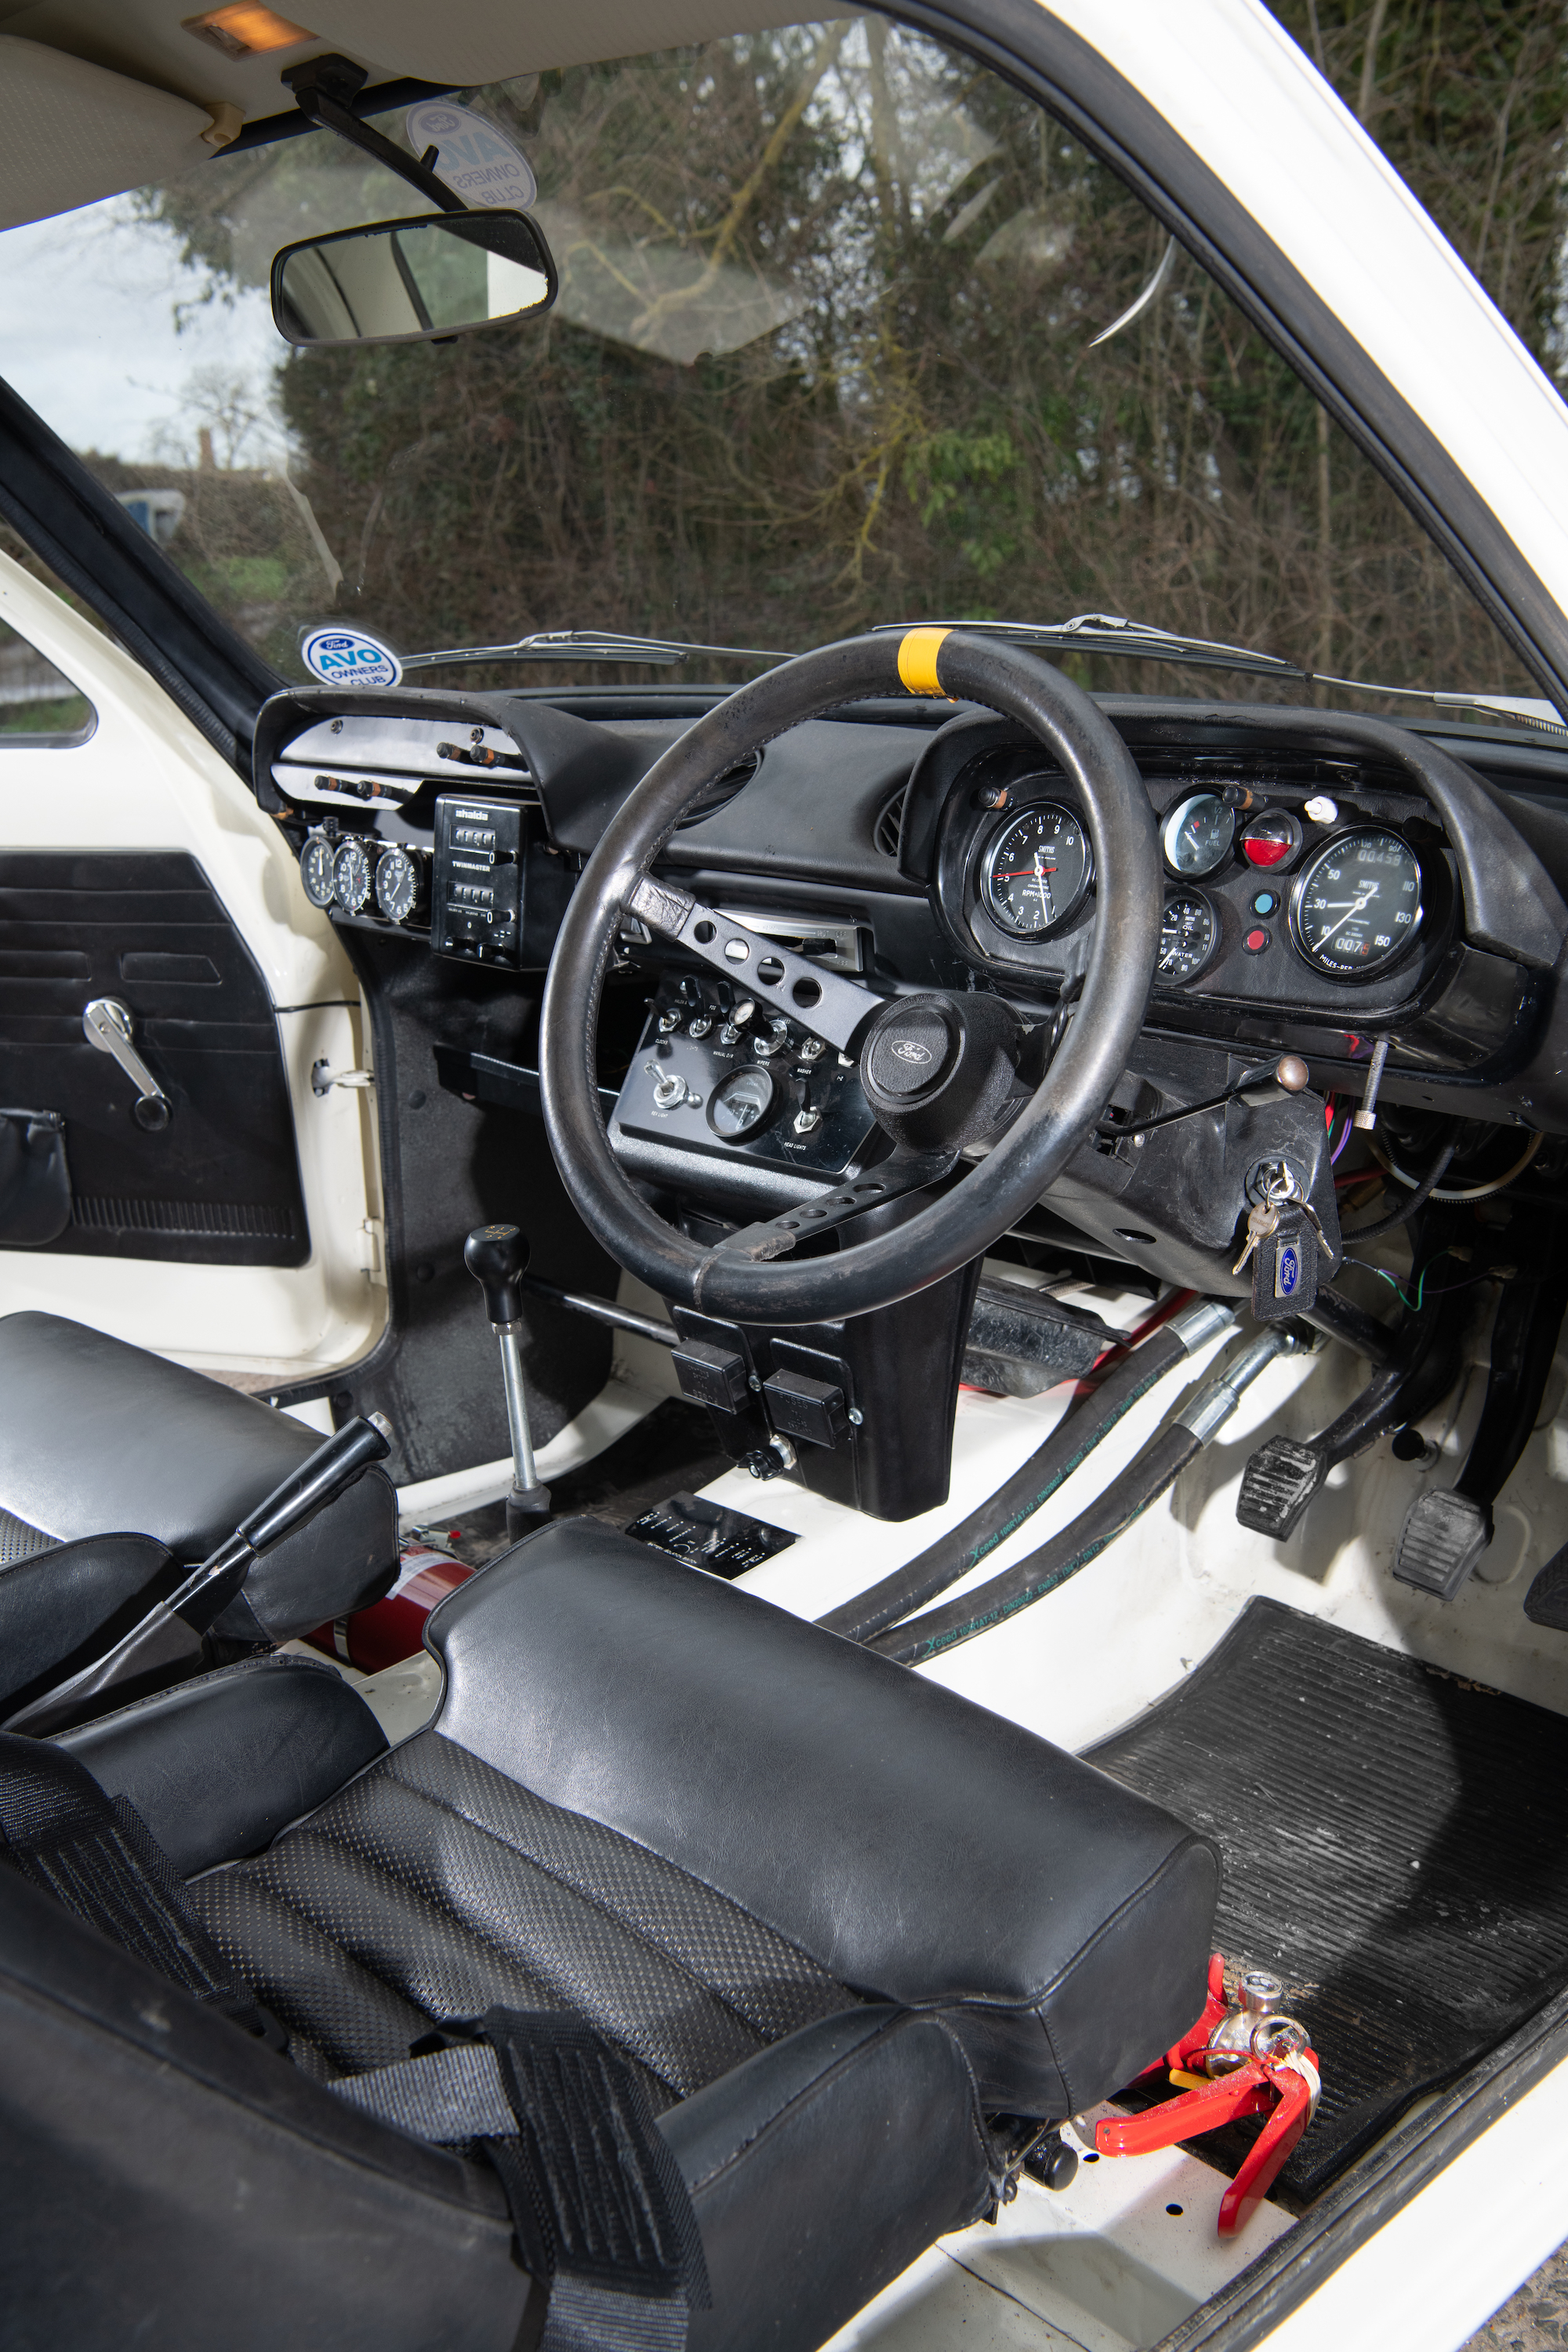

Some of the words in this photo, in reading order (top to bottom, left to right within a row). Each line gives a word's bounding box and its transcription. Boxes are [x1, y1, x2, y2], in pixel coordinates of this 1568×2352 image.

[325, 640, 349, 649] Ford
[319, 649, 382, 670] AVO
[331, 665, 389, 679] OWNERS
[350, 676, 387, 685] CLUB
[461, 809, 488, 821] halda
[1037, 825, 1044, 835] 8
[1054, 825, 1061, 834] 9
[1022, 836, 1029, 844] 7
[1066, 837, 1074, 846] 10
[1038, 845, 1055, 854] SMITHS
[350, 852, 357, 861] 12
[1008, 852, 1015, 862] 6
[340, 862, 347, 872] 10
[395, 859, 402, 868] 12
[452, 861, 490, 872] TWINMASTER
[339, 873, 343, 881] 9
[385, 870, 392, 879] 10
[1328, 869, 1341, 880] 50
[340, 884, 346, 893] 8
[383, 880, 389, 889] 9
[1359, 880, 1380, 890] SMITHS
[1403, 881, 1415, 891] 110
[345, 893, 350, 902] 7
[358, 895, 363, 904] 5
[385, 892, 390, 901] 8
[1008, 893, 1014, 902] 4
[351, 898, 356, 906] 6
[390, 902, 395, 911] 7
[1314, 898, 1327, 909] 30
[397, 906, 401, 914] 6
[403, 904, 408, 913] 5
[1018, 906, 1025, 916] 3
[1033, 910, 1040, 920] 2
[1395, 912, 1411, 924] 130
[1321, 925, 1330, 936] 10
[1374, 935, 1391, 947] 150
[898, 1044, 925, 1061] Ford
[1283, 1258, 1295, 1286] Ford
[968, 1533, 999, 1569] Xceed
[1000, 1502, 1035, 1537] 100R1AT-12
[1037, 1473, 1064, 1503] DIN20022
[1065, 1452, 1083, 1473] EN853
[1102, 1414, 1118, 1432] DN12
[1120, 1396, 1134, 1414] MWP
[1134, 1386, 1145, 1398] 105
[1145, 1374, 1158, 1389] BAR
[922, 1629, 957, 1658] Xceed
[960, 1611, 998, 1637] 100R1AT-12
[1003, 1591, 1033, 1614] DIN20022
[1037, 1574, 1059, 1594] EN853
[1083, 1544, 1100, 1562] DN12
